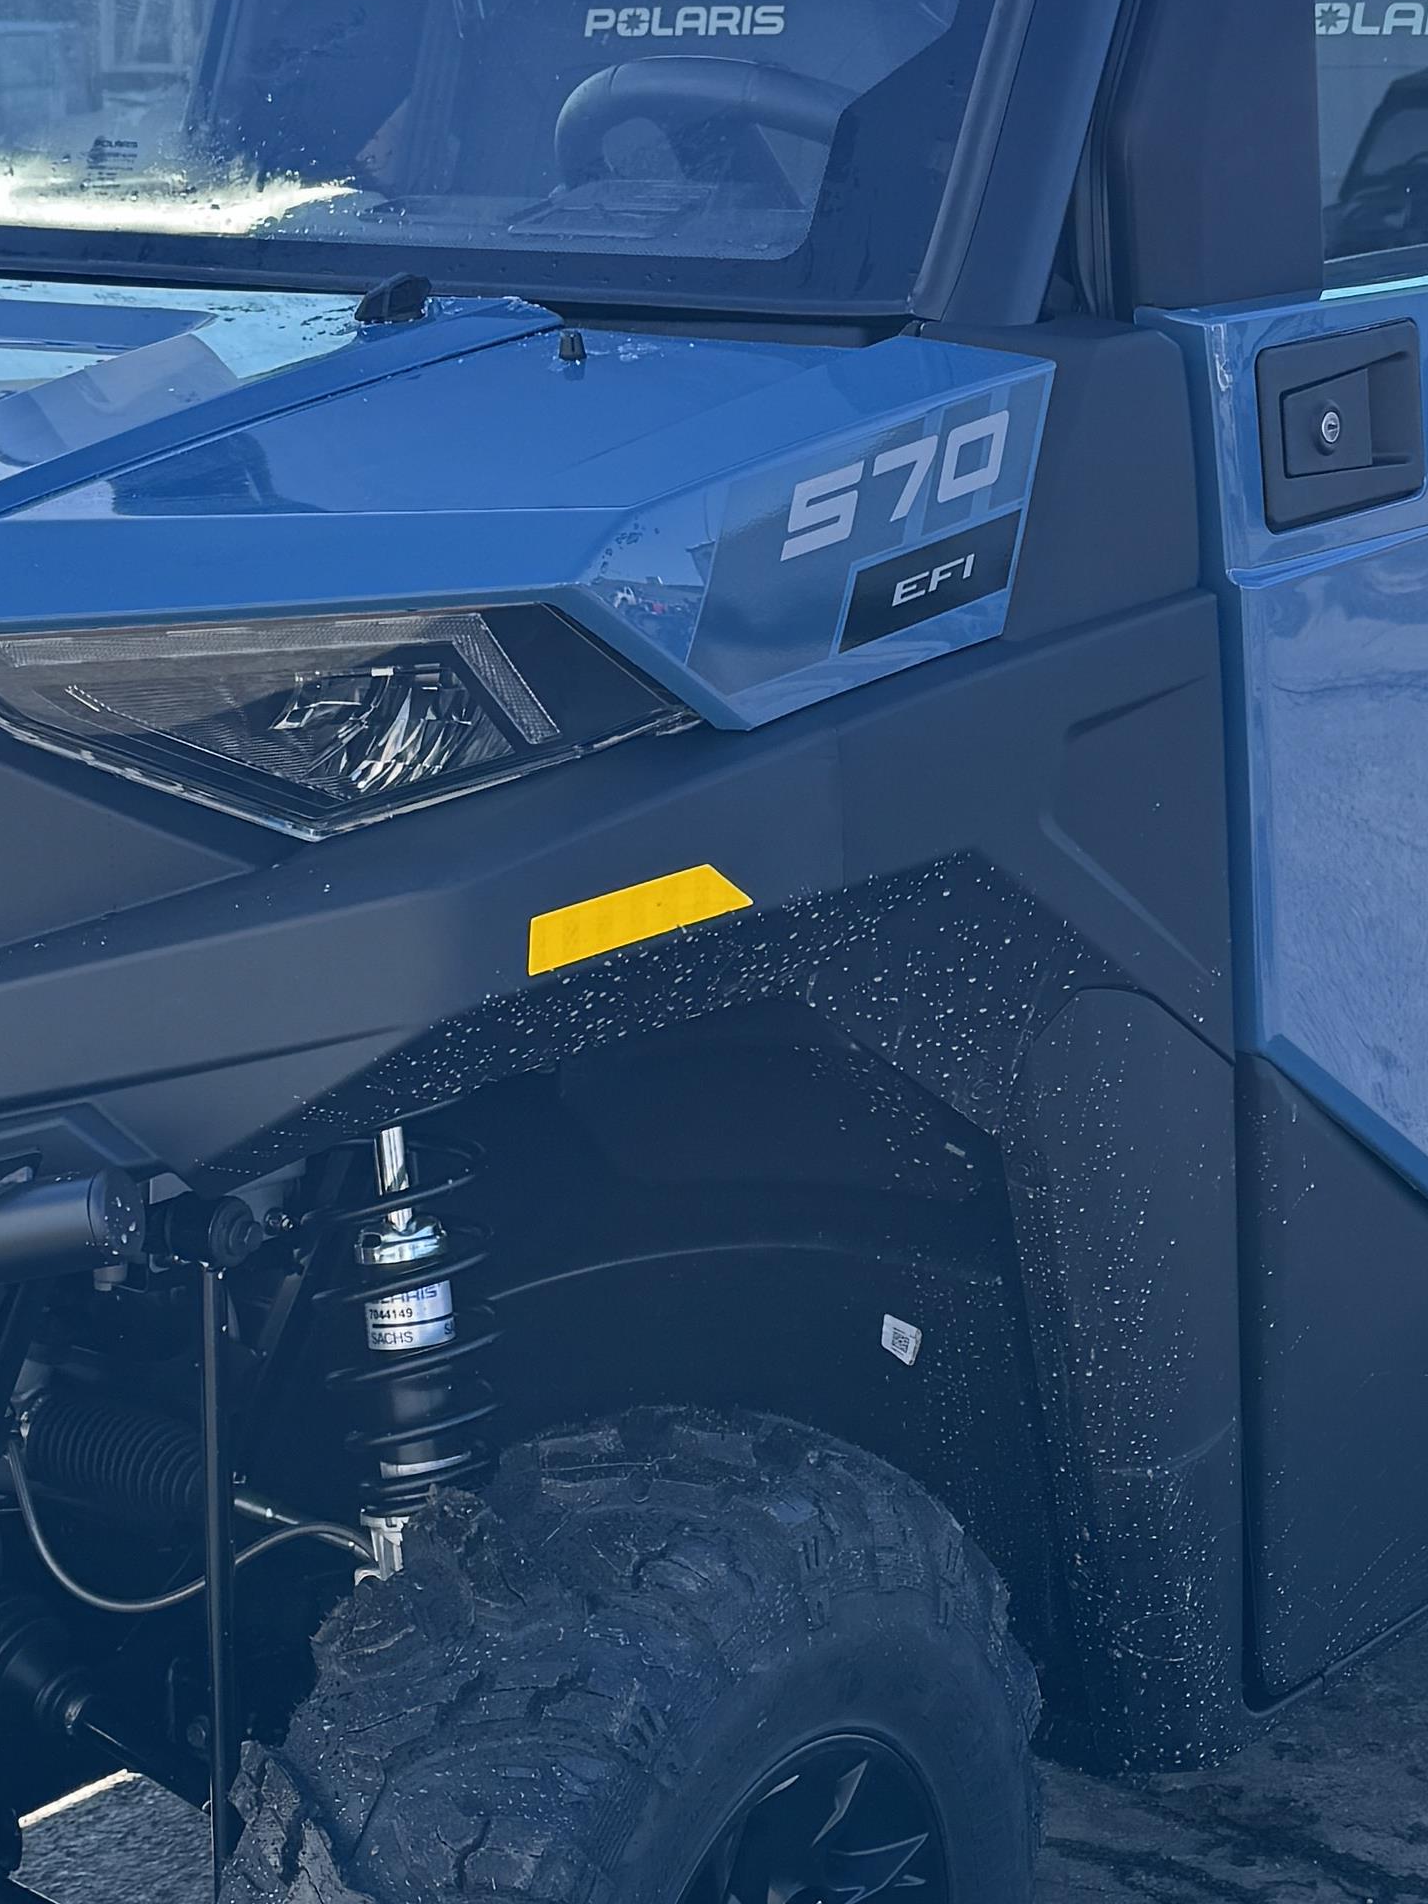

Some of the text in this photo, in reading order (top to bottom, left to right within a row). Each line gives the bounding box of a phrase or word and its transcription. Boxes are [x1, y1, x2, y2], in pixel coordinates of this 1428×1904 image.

[584, 5, 786, 38] POLARIS
[780, 409, 1010, 562] 570
[891, 553, 975, 608] EFI
[368, 1307, 414, 1320] 7044149
[372, 1331, 415, 1345] SACHS
